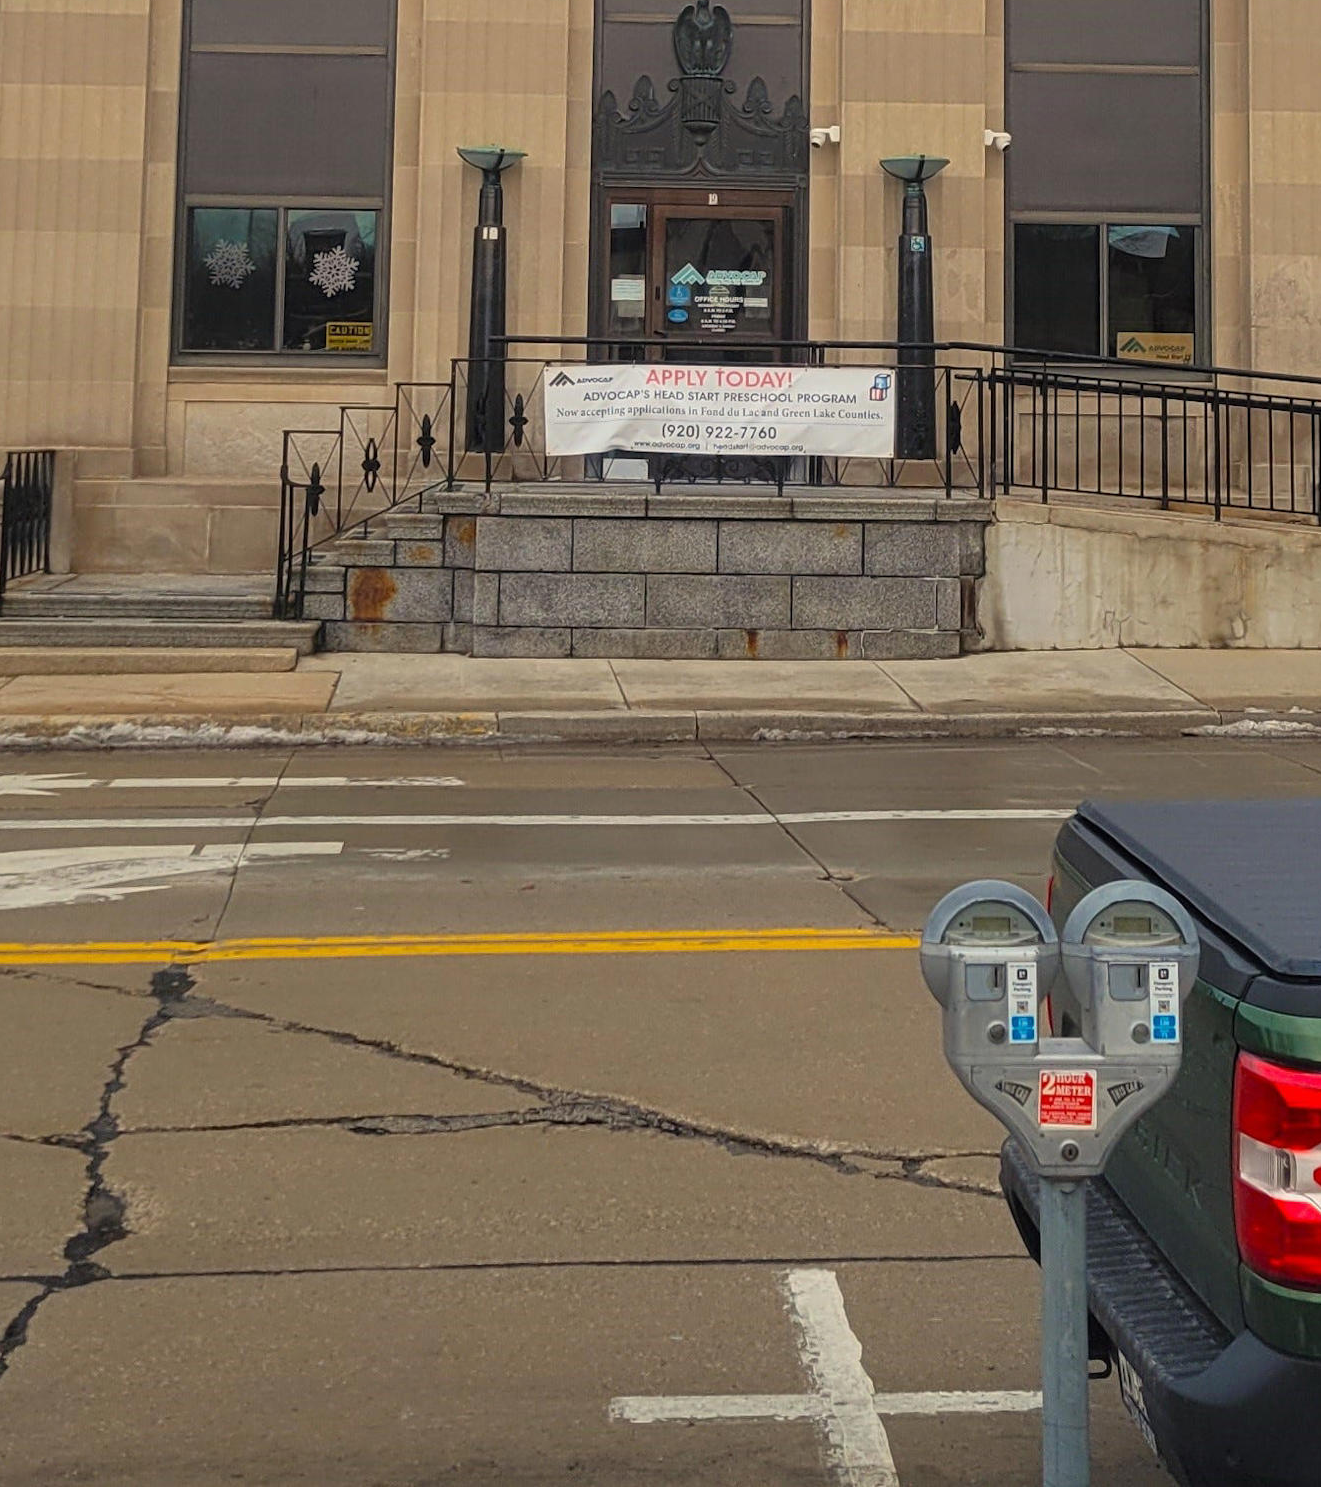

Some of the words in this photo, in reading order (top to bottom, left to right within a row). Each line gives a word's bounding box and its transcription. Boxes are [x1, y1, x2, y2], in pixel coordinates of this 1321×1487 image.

[708, 193, 718, 205] 19
[707, 270, 767, 280] ADVOCAP
[646, 369, 707, 386] APPLY
[715, 370, 793, 388] TODAY!
[583, 389, 650, 402] ADVOCAP'S
[654, 391, 685, 401] HEAD
[688, 392, 719, 401] START
[723, 393, 793, 403] PRESCHOOL
[797, 393, 857, 404] PROGRAM
[556, 408, 578, 417] Now
[580, 406, 625, 418] accepting
[628, 405, 686, 418] applications
[688, 406, 698, 416] in
[701, 407, 724, 416] Fond
[728, 408, 740, 417] du
[742, 408, 760, 417] Lac
[761, 408, 779, 417] and
[781, 408, 811, 418] Green
[814, 409, 836, 418] Lake
[838, 409, 883, 420] Counties.
[662, 423, 700, 439] (920)
[705, 425, 777, 439] 922-7760
[634, 441, 700, 451] www.advocap.org
[1042, 1073, 1056, 1096] 2
[1055, 1085, 1092, 1097] METER
